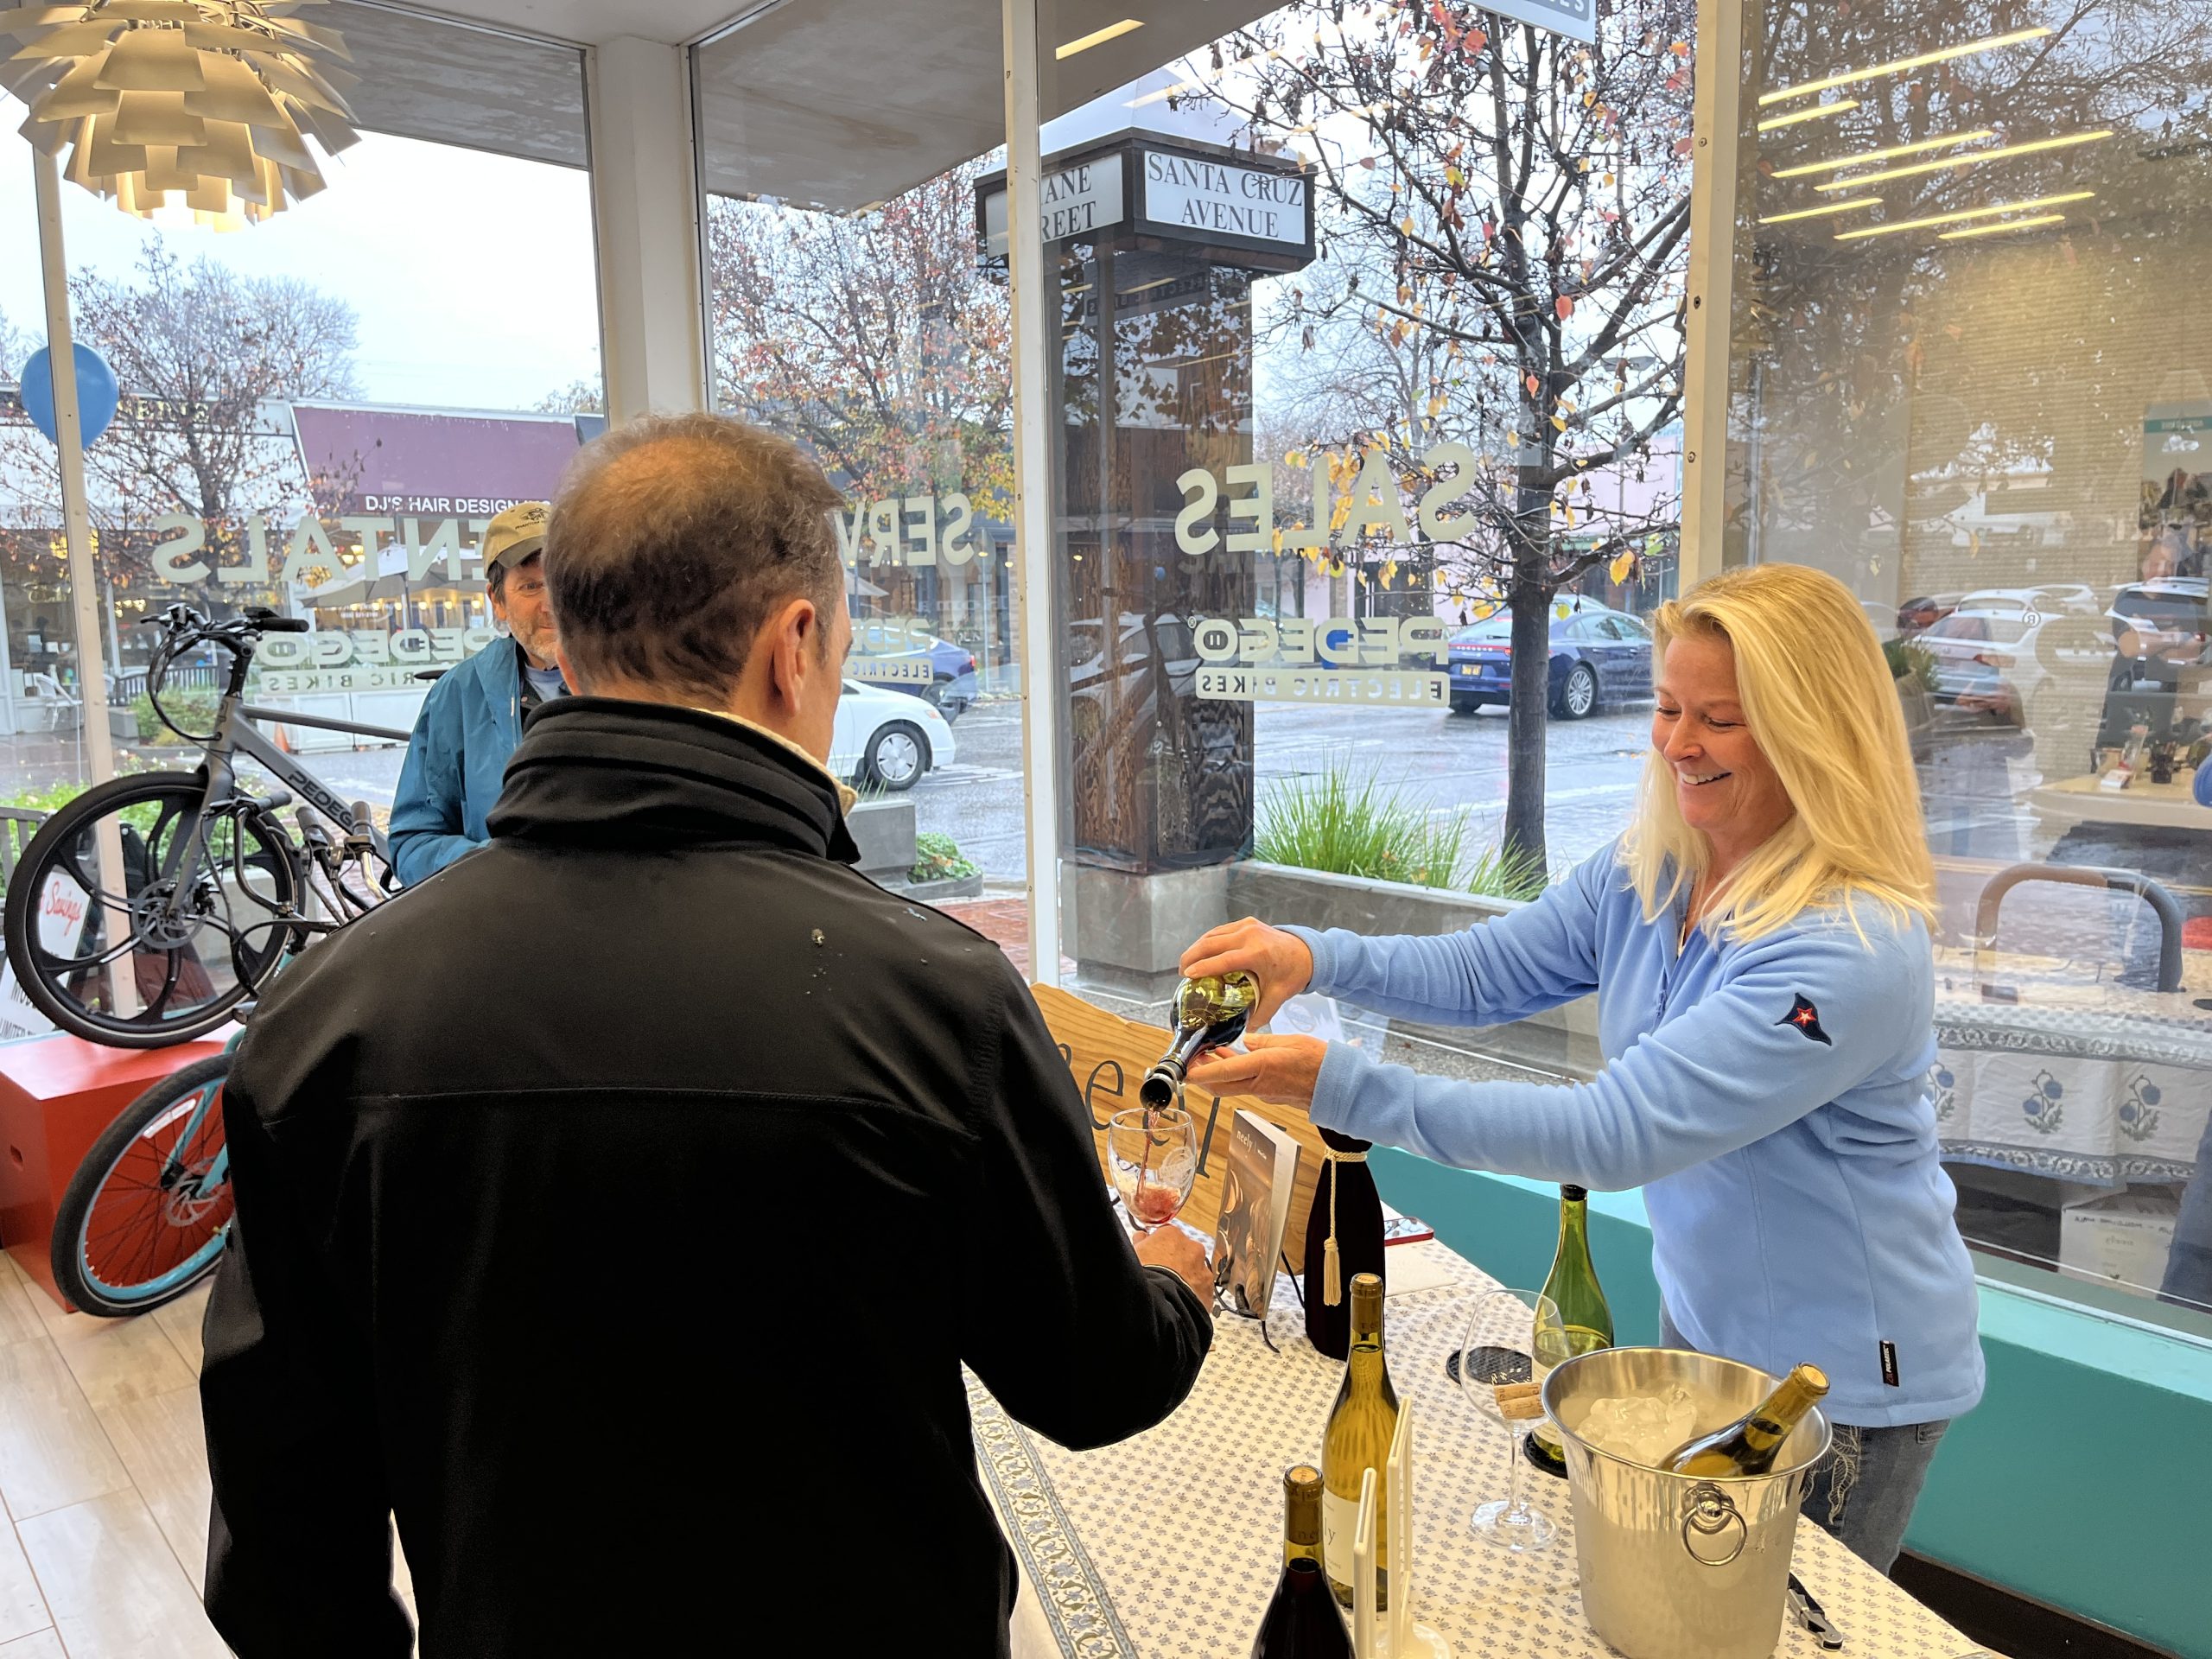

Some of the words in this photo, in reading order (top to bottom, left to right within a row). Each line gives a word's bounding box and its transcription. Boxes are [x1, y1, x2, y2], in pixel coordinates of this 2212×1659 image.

[1041, 165, 1092, 204] ANE
[1148, 153, 1230, 194] SANTA
[1241, 172, 1304, 207] CRUZ
[1041, 200, 1096, 241] REET
[1181, 198, 1280, 238] AVENUE
[365, 496, 403, 512] DJ'S
[409, 497, 451, 513] HAIR
[289, 770, 353, 828] PEDEG
[47, 880, 82, 937] Savings
[1236, 1130, 1253, 1153] neely
